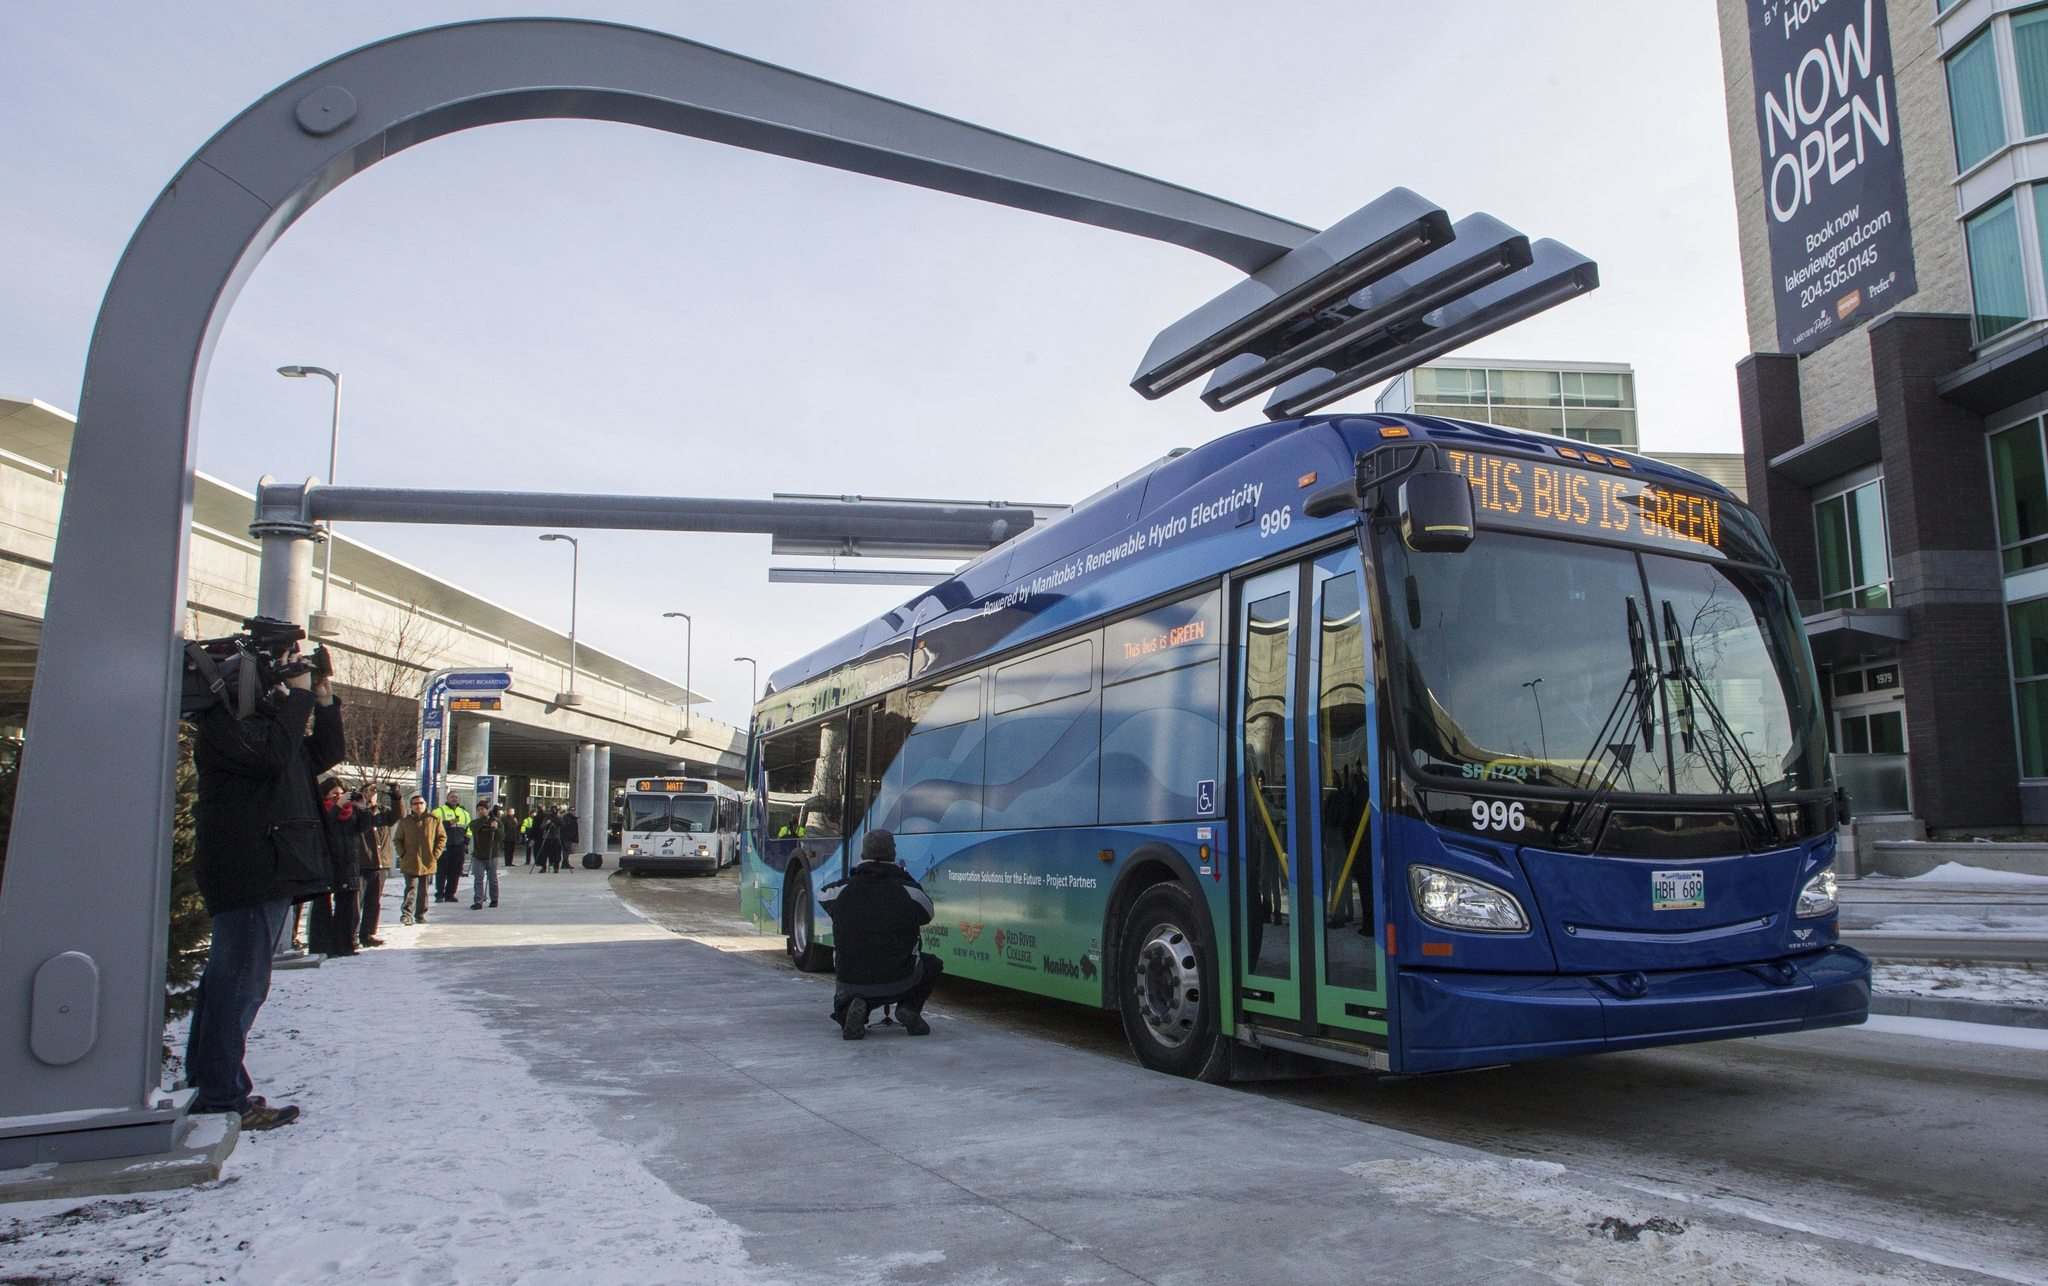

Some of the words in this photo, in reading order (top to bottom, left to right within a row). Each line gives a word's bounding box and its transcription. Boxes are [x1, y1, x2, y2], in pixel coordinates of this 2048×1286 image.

[1764, 0, 1872, 157] NOW
[1770, 75, 1889, 222] OPEN
[1784, 210, 1891, 293] lakeviewgrand.com
[1806, 220, 1835, 253] Book
[1835, 204, 1860, 233] now
[1800, 244, 1878, 309] 204.505.0145
[1260, 505, 1291, 539] 996
[1449, 452, 1523, 514] THIS
[1534, 467, 1590, 525] BUS
[1600, 479, 1629, 531] IS
[1639, 487, 1720, 546] GREEN
[983, 587, 1018, 617] Powered
[1019, 583, 1030, 604] by
[1031, 557, 1084, 597] Manitoba's
[1085, 531, 1146, 574] Renewable
[1148, 516, 1187, 548] Hydro
[1190, 482, 1263, 529] Electricity
[1169, 620, 1205, 647] GREEN
[1471, 800, 1526, 832] 996
[948, 869, 980, 883] Transportation
[981, 871, 1004, 884] Solutions
[1013, 872, 1022, 885] the
[1023, 872, 1042, 886] Future
[1046, 873, 1067, 889] Project
[1069, 875, 1097, 888] Partners
[1655, 880, 1676, 899] HBH
[1682, 880, 1702, 898] 689
